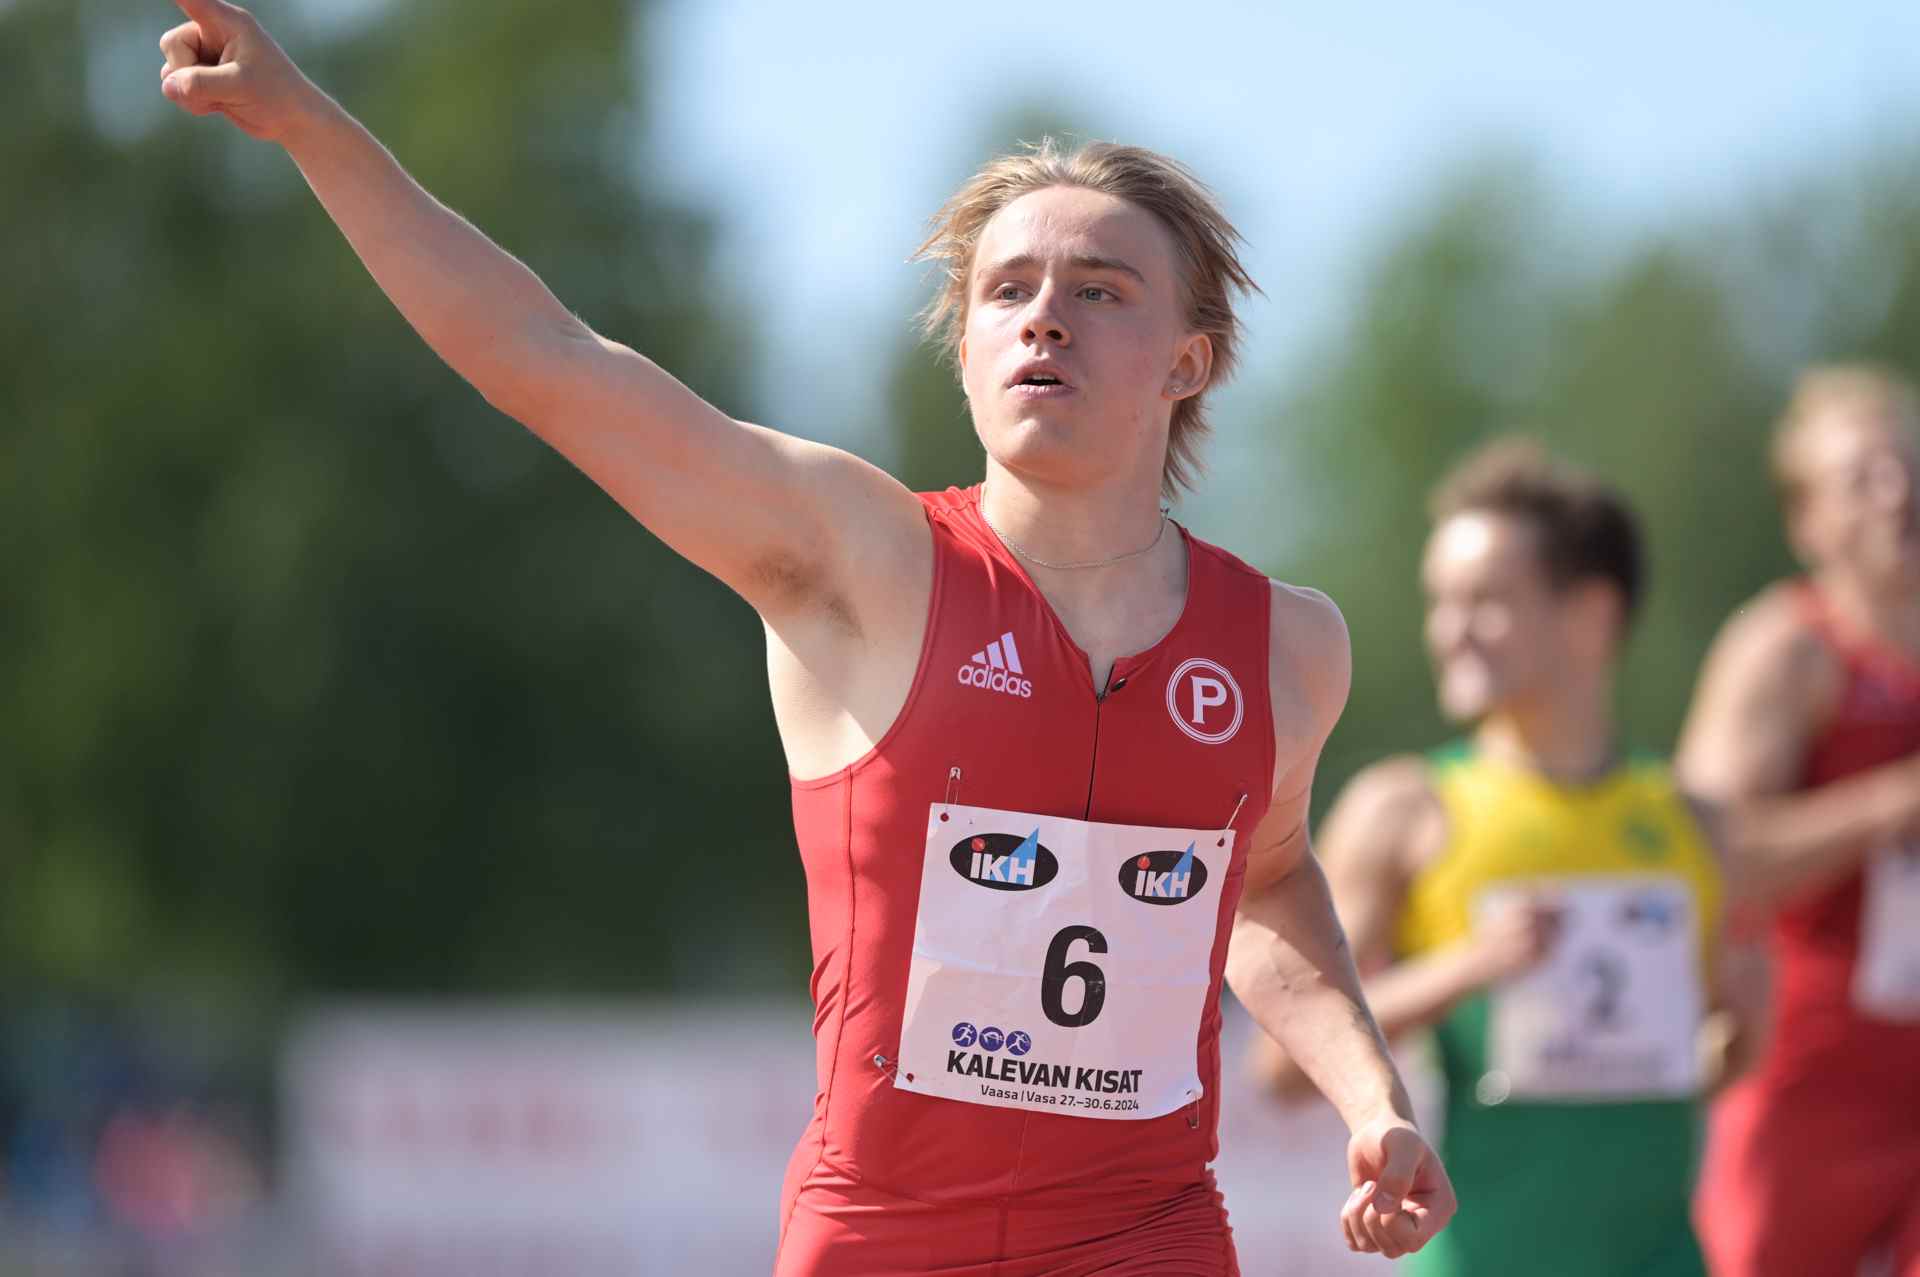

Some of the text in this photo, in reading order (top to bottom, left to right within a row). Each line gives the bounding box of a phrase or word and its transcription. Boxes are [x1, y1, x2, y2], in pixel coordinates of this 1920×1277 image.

[957, 664, 1032, 698] adidas
[1190, 675, 1227, 724] P
[1041, 925, 1108, 1028] 6
[947, 1050, 1142, 1093] KALEVAN KISAT
